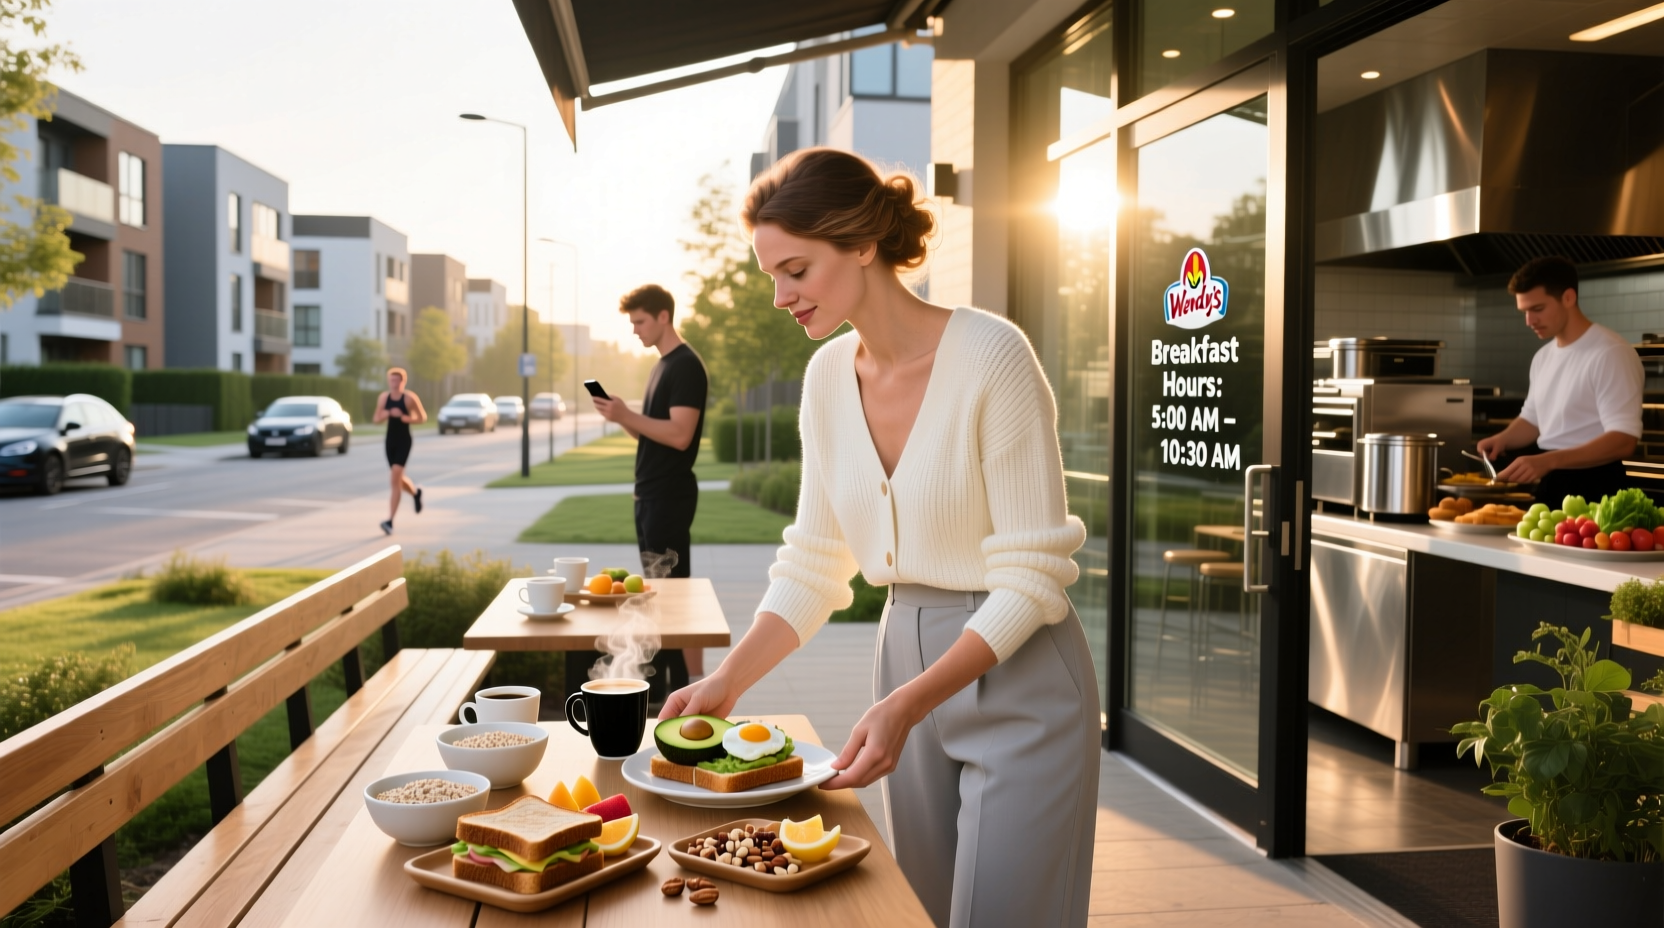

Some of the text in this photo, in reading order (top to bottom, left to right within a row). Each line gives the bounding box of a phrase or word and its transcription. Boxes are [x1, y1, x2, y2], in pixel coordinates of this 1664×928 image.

[1169, 285, 1222, 320] Wendy's
[1151, 334, 1239, 366] Breakfast
[1162, 370, 1223, 398] Hours:
[1151, 404, 1187, 431] 5:00
[1190, 406, 1219, 433] AM
[1160, 438, 1241, 471] 10:30 AM
